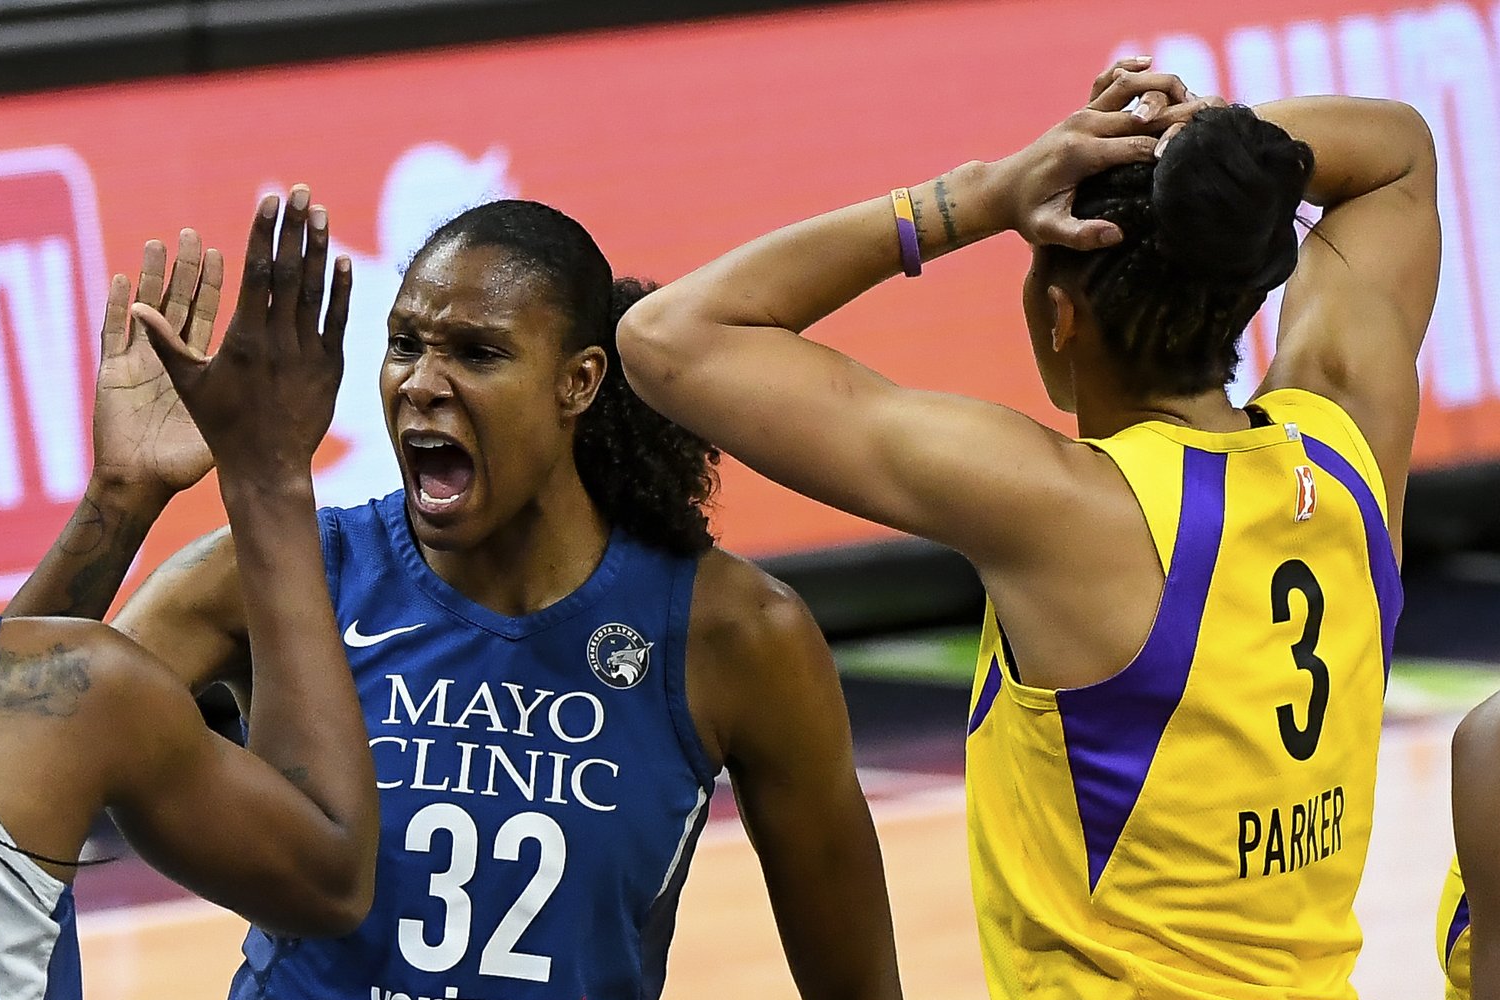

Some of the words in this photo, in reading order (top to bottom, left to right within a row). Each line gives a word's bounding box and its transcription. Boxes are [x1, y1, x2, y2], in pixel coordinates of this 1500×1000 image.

[589, 626, 613, 671] MINNESOTA
[616, 626, 638, 641] LYNX
[1271, 558, 1330, 761] 3
[381, 674, 605, 744] MAYO
[367, 736, 619, 812] CLINIC
[1238, 786, 1344, 879] PARKER
[398, 803, 567, 983] 32
